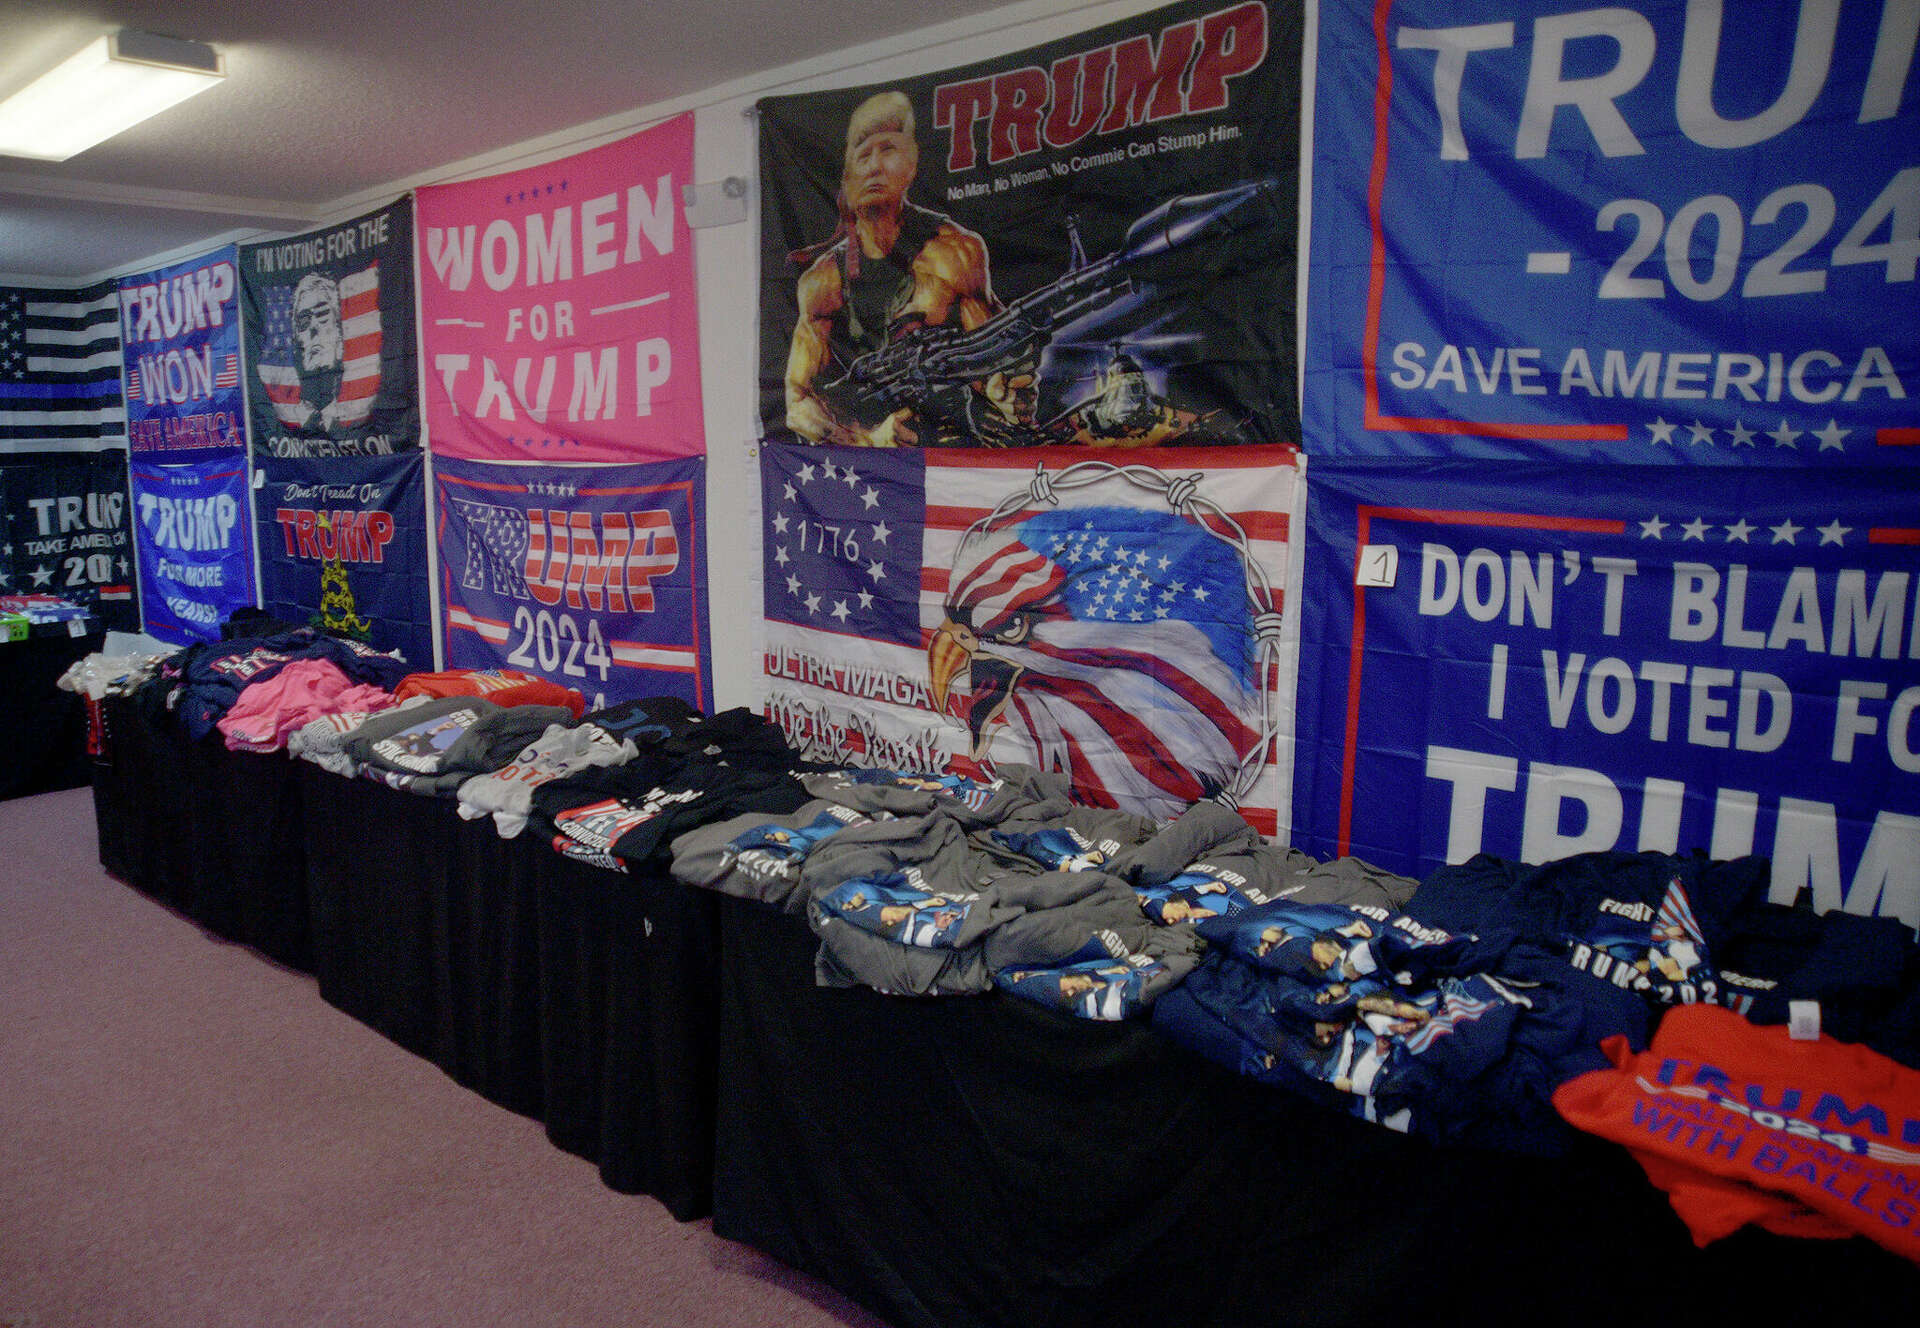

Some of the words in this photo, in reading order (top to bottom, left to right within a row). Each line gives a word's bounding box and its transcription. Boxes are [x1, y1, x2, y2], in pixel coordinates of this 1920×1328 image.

[932, 1, 1269, 173] TRUMP
[947, 186, 964, 201] No
[964, 182, 991, 198] Man,
[994, 177, 1009, 192] No
[1052, 161, 1069, 176] No
[1071, 147, 1125, 172] Commie
[1128, 141, 1156, 159] Can
[1158, 133, 1205, 152] Stump
[1209, 124, 1243, 142] Him.
[257, 247, 274, 273] I'M
[276, 238, 325, 271] VOTING
[327, 228, 357, 261] FOR
[359, 213, 390, 250] THE
[427, 173, 674, 292] WOMEN
[1595, 166, 1920, 302] 2024
[120, 261, 237, 345] TRUMP
[506, 301, 575, 343] FOR
[138, 344, 214, 406] WON
[435, 337, 672, 424] TRUMP
[1389, 342, 1547, 396] SAVE
[1559, 347, 1907, 404] AMERICA
[137, 493, 237, 552] TRUMP
[284, 483, 318, 502] Don't
[319, 484, 357, 503] Tread
[359, 483, 382, 503] On
[24, 538, 68, 556] TAKE
[276, 508, 395, 564] TRUMP
[451, 497, 680, 613] TRUMP
[796, 519, 860, 563] 1776
[1369, 550, 1393, 584] 1
[184, 565, 223, 588] MORE
[1418, 542, 1638, 637] DON'T
[1669, 561, 1920, 660] BLAM
[507, 606, 611, 682] 2024
[767, 643, 840, 691] ULTRA
[842, 663, 932, 711] MAGA
[1487, 643, 1509, 720] I
[1541, 649, 1793, 754] VOTED
[1216, 870, 1247, 886] FOR
[1599, 898, 1655, 922] FIGHT
[1632, 1099, 1745, 1160] WITH
[1720, 1096, 1857, 1154] 2024
[1769, 1131, 1920, 1202] SOMEON
